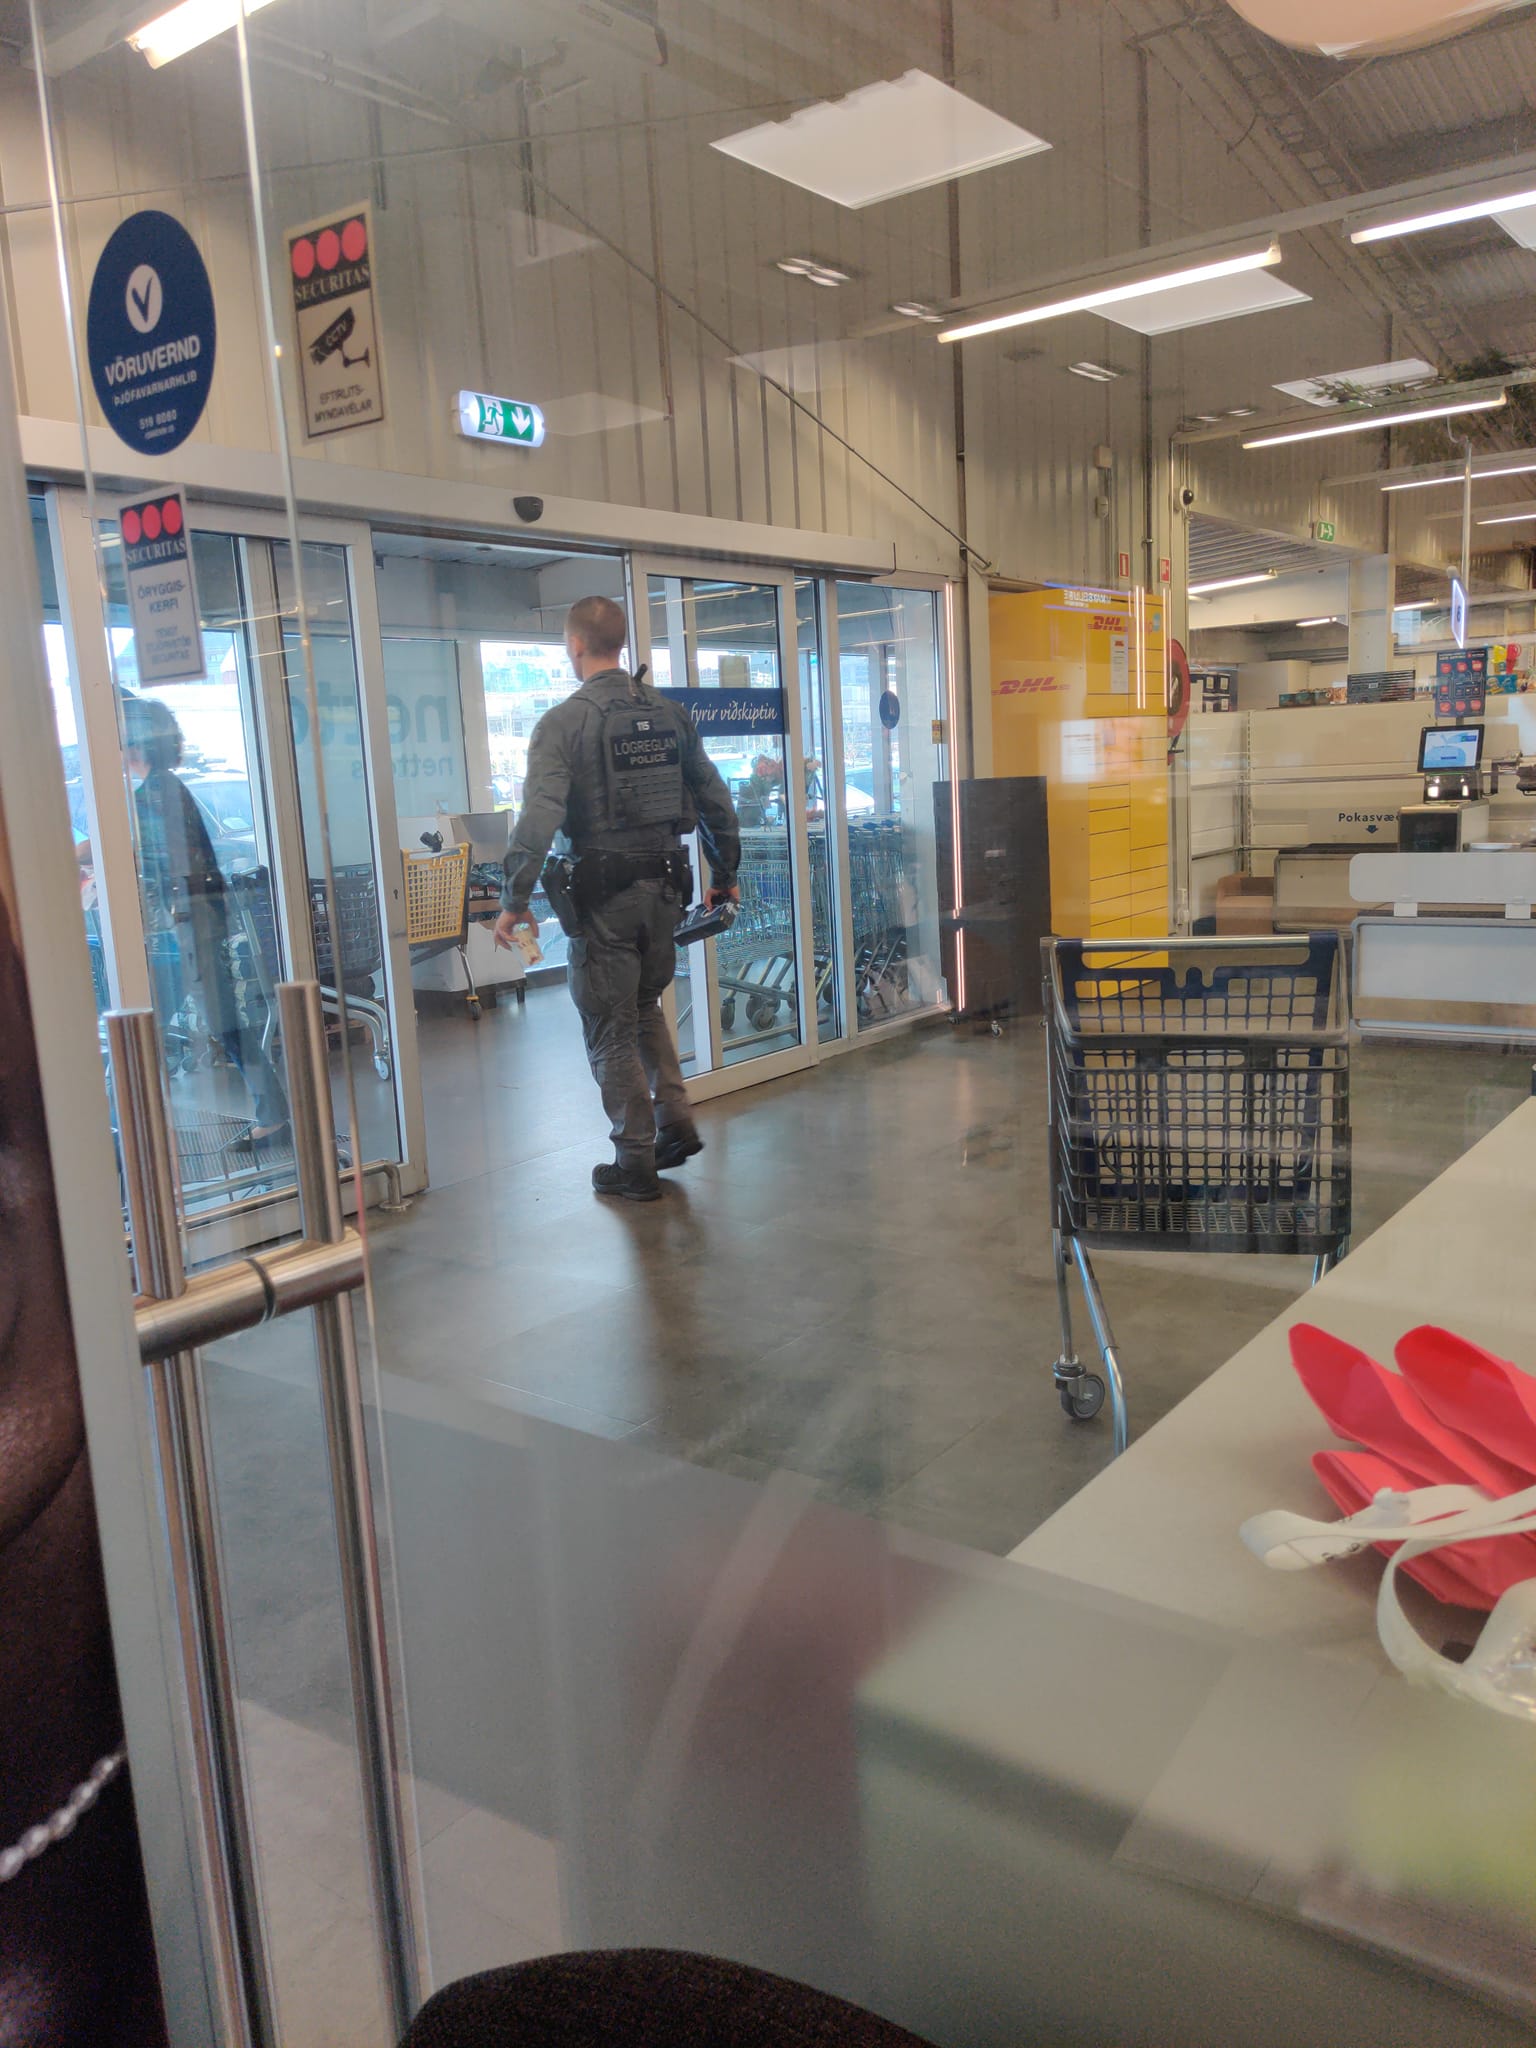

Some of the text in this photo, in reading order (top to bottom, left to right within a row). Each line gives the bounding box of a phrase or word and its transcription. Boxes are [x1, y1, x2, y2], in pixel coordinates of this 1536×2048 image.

[296, 265, 370, 299] SECURITAS
[104, 335, 200, 386] VÖRUVERND
[126, 538, 186, 563] SECURITAS
[1090, 615, 1124, 632] DHL
[998, 676, 1058, 695] DHL
[690, 700, 778, 728] fyrir viðskiptin
[630, 752, 668, 766] POLICE
